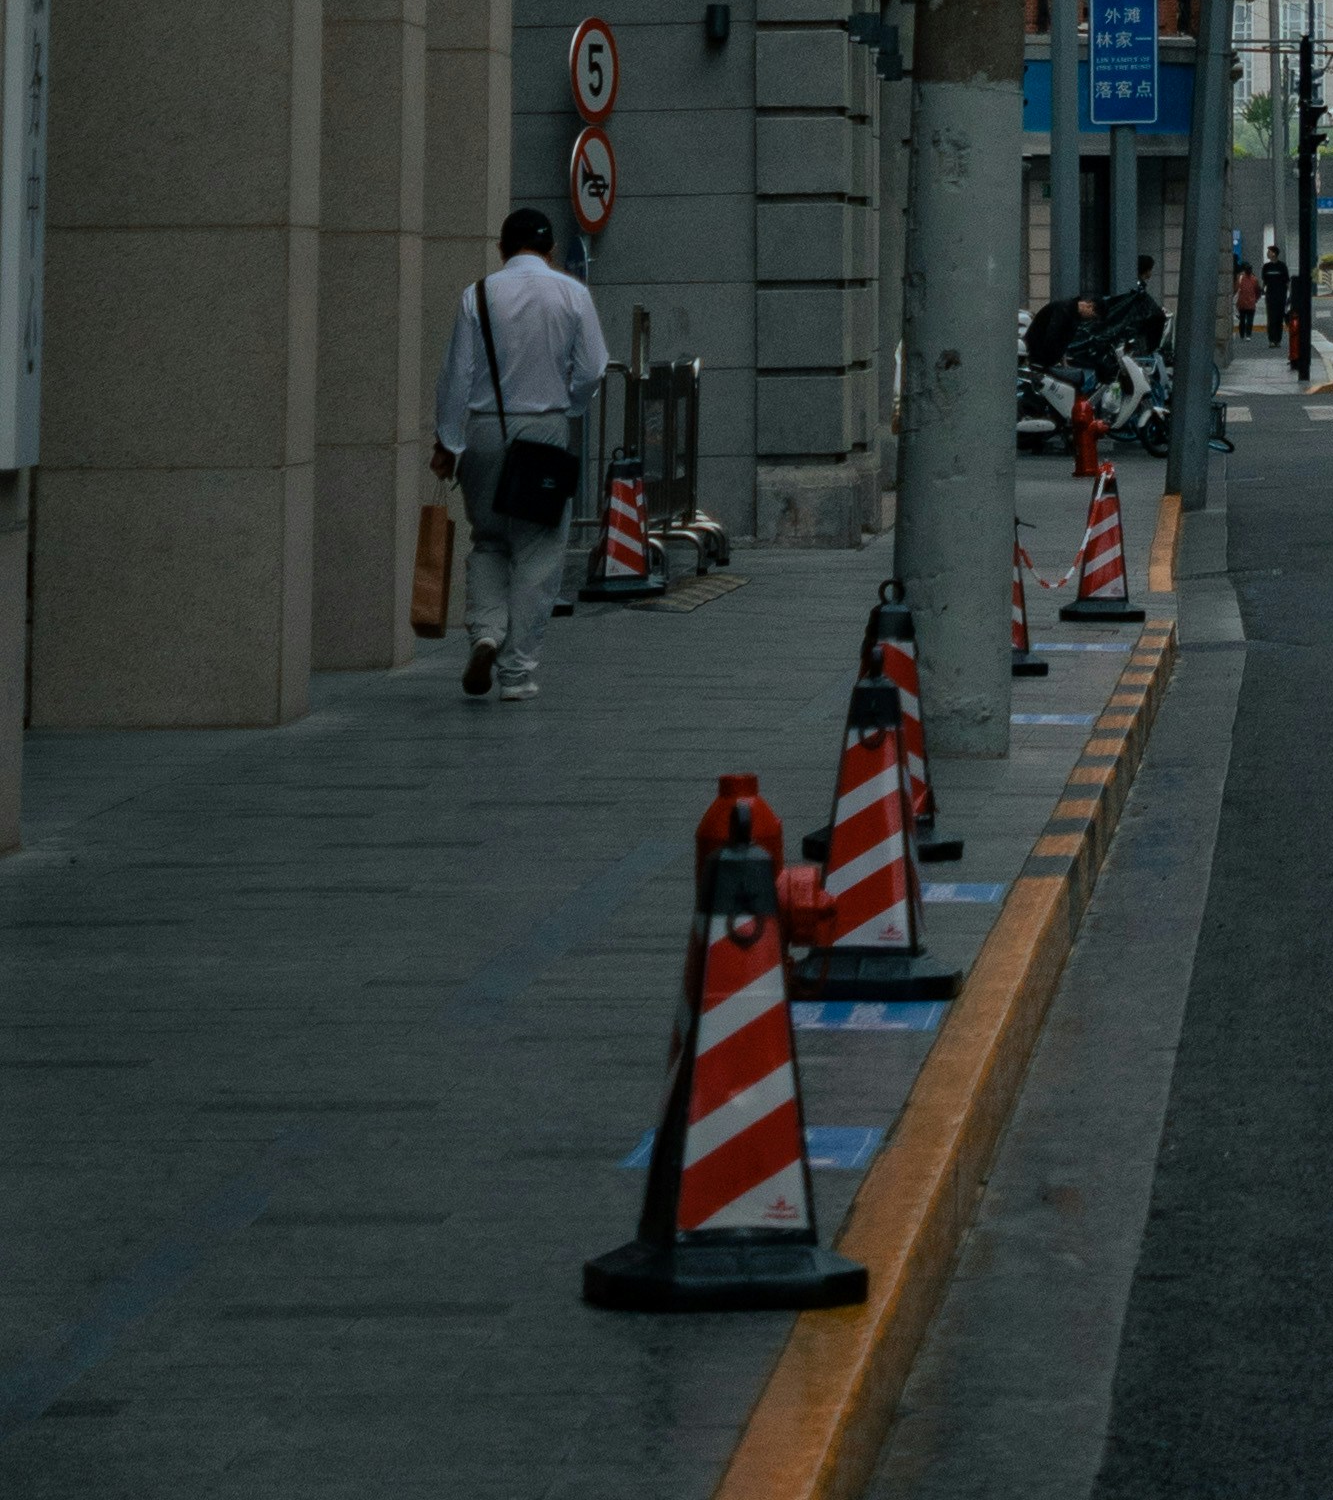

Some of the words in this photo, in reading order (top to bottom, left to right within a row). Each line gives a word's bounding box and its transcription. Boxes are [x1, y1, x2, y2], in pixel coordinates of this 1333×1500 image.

[1104, 7, 1141, 24] 外滩
[1096, 31, 1152, 49] 林家一
[587, 43, 604, 97] 5
[1095, 80, 1153, 99] 落客点
